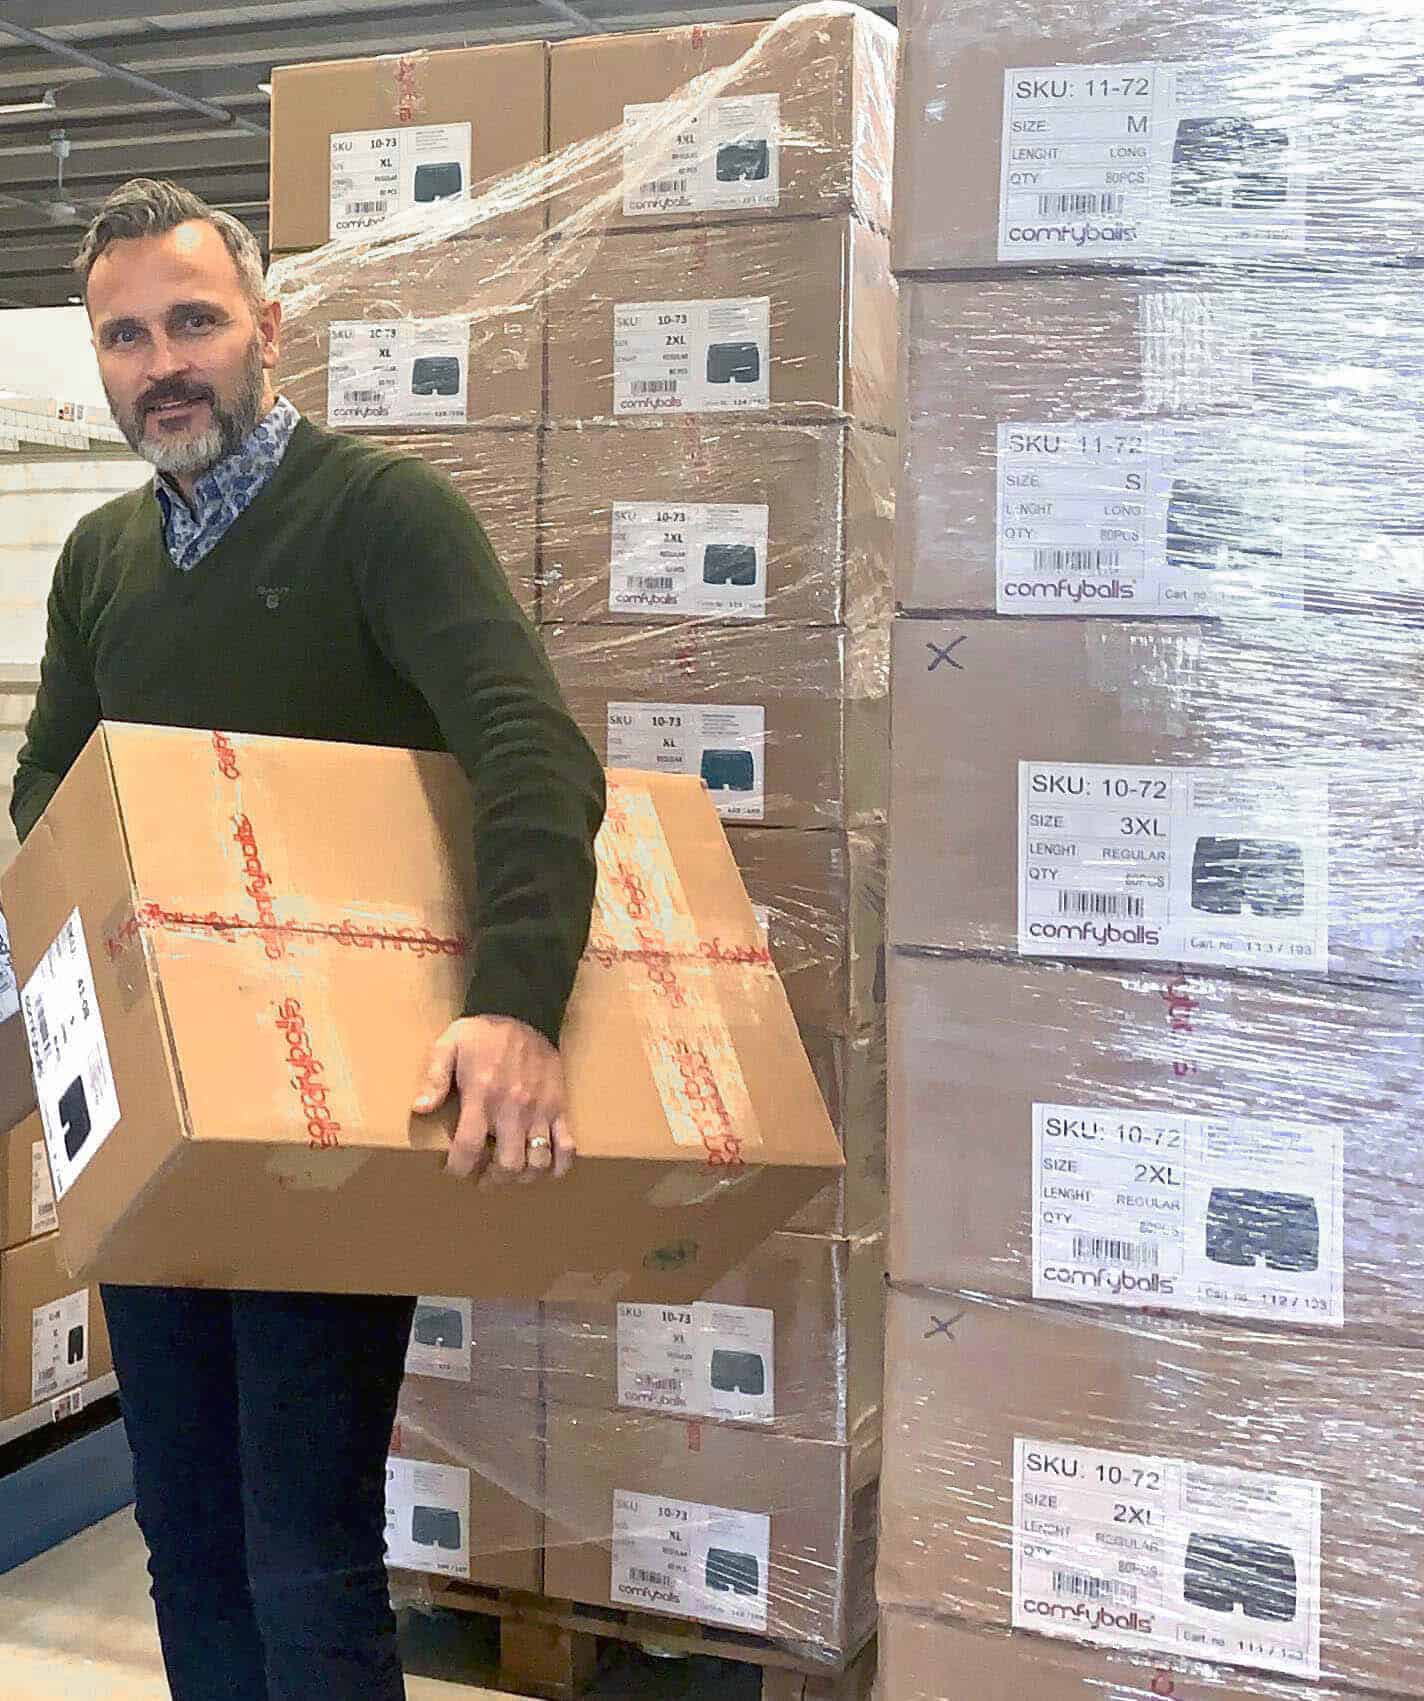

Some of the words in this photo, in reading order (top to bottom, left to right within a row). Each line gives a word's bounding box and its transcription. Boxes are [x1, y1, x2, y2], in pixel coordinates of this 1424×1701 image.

[1016, 80, 1074, 98] SKU:
[1085, 78, 1148, 96] 11-72
[1127, 116, 1147, 132] M
[370, 138, 397, 149] 10-73
[1110, 147, 1146, 158] LONG
[380, 158, 392, 167] XL
[658, 315, 687, 325] 10-73
[665, 336, 686, 345] 2XL
[379, 349, 391, 358] XL
[1125, 474, 1141, 490] S
[656, 512, 685, 522] 10-73
[1104, 505, 1141, 516] LONG
[1004, 579, 1134, 602] comfyballs
[652, 716, 681, 727] 10-73
[1032, 775, 1091, 795] SKU:
[1103, 779, 1167, 799] 10-72
[1120, 817, 1166, 836] 3XL
[1102, 848, 1166, 861] REGULAR
[1029, 868, 1057, 881] QTY
[1029, 922, 1160, 946] comfyballs
[1045, 1118, 1104, 1141] SKU:
[1117, 1124, 1181, 1148] 10-72
[1134, 1164, 1181, 1186] 2XL
[1116, 1194, 1180, 1210] REGULAR
[1043, 1267, 1174, 1295] comfyballs
[662, 1311, 691, 1324] 10-73
[1095, 1464, 1160, 1491] 10-72
[658, 1507, 687, 1521] 10-73
[1113, 1504, 1155, 1526] 2XL
[1023, 1599, 1154, 1634] comfyballs
